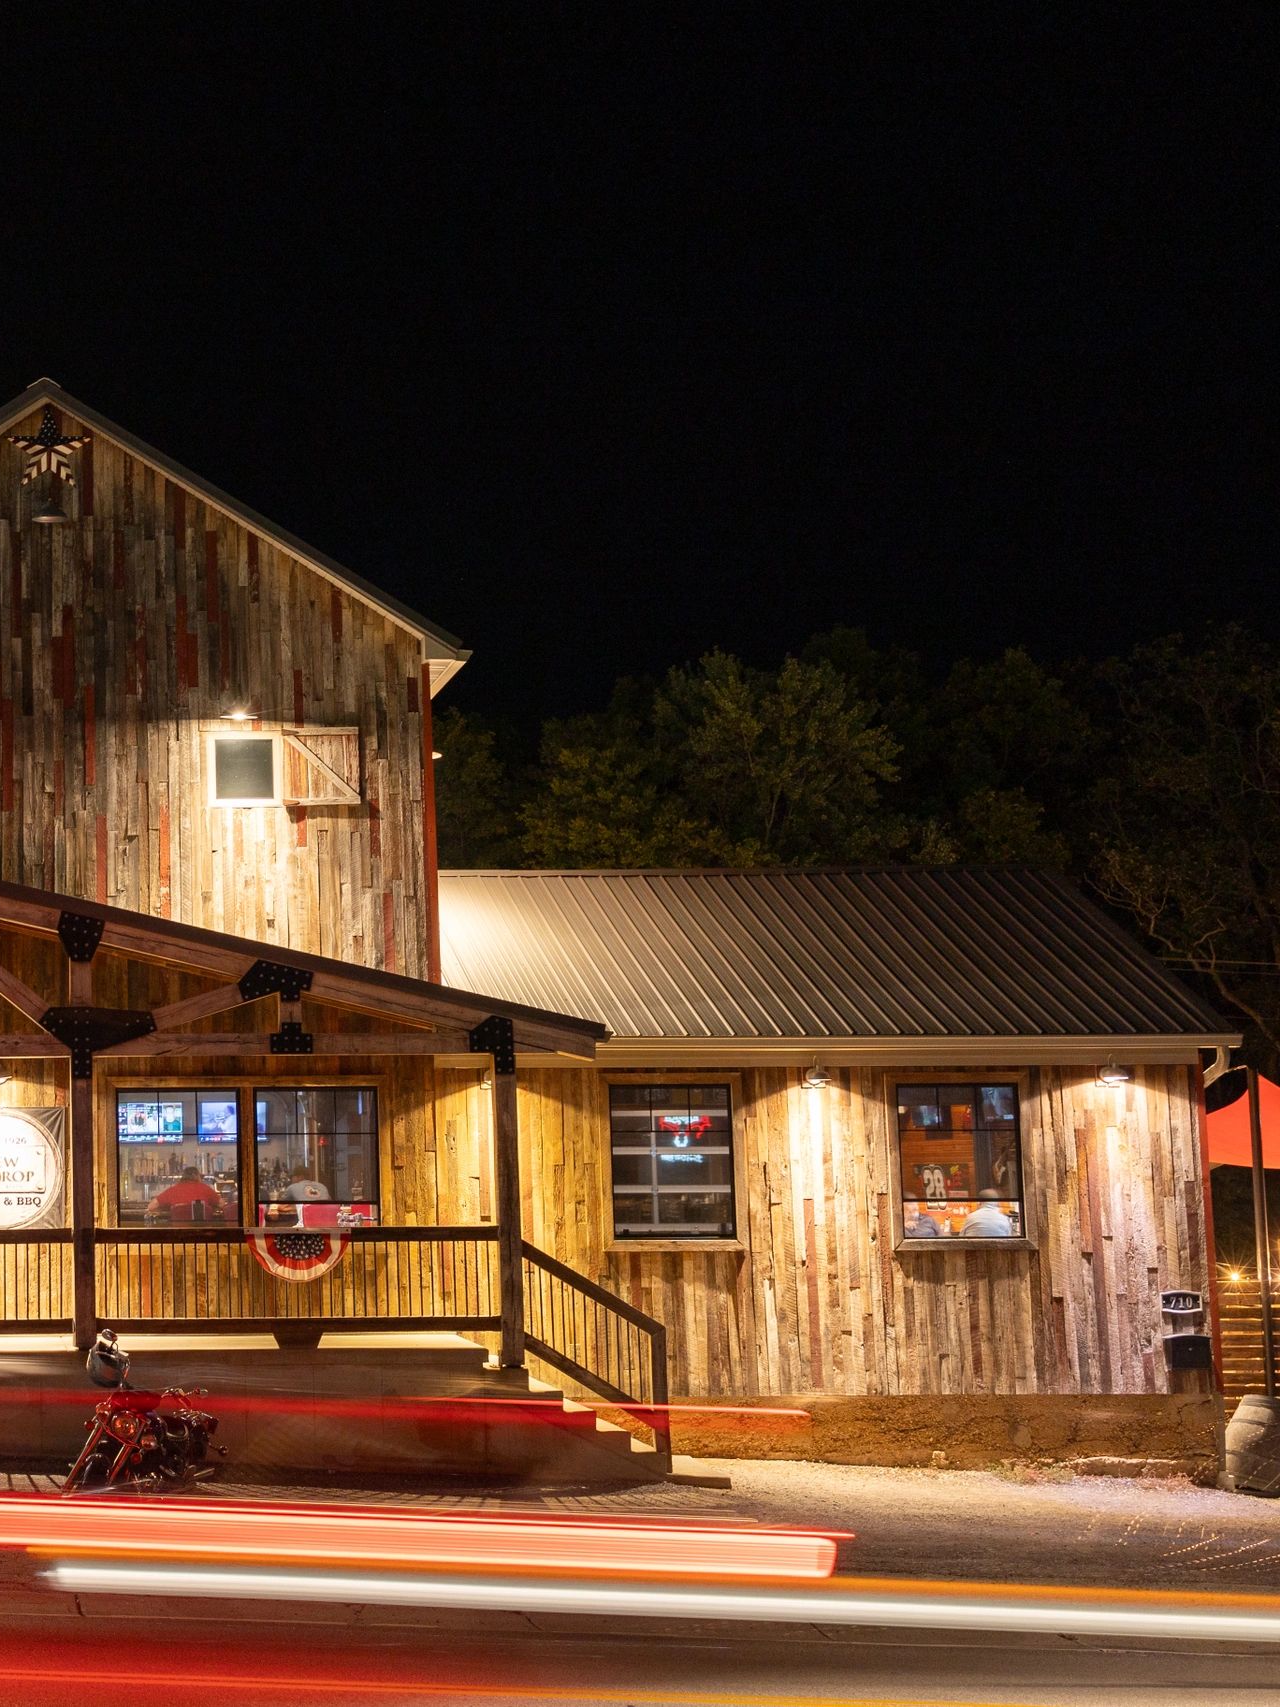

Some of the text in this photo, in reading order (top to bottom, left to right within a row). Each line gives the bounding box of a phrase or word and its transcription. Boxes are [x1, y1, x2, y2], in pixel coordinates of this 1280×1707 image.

[3, 1196, 13, 1206] &
[16, 1196, 42, 1208] BBQ
[1170, 1297, 1193, 1308] 710
